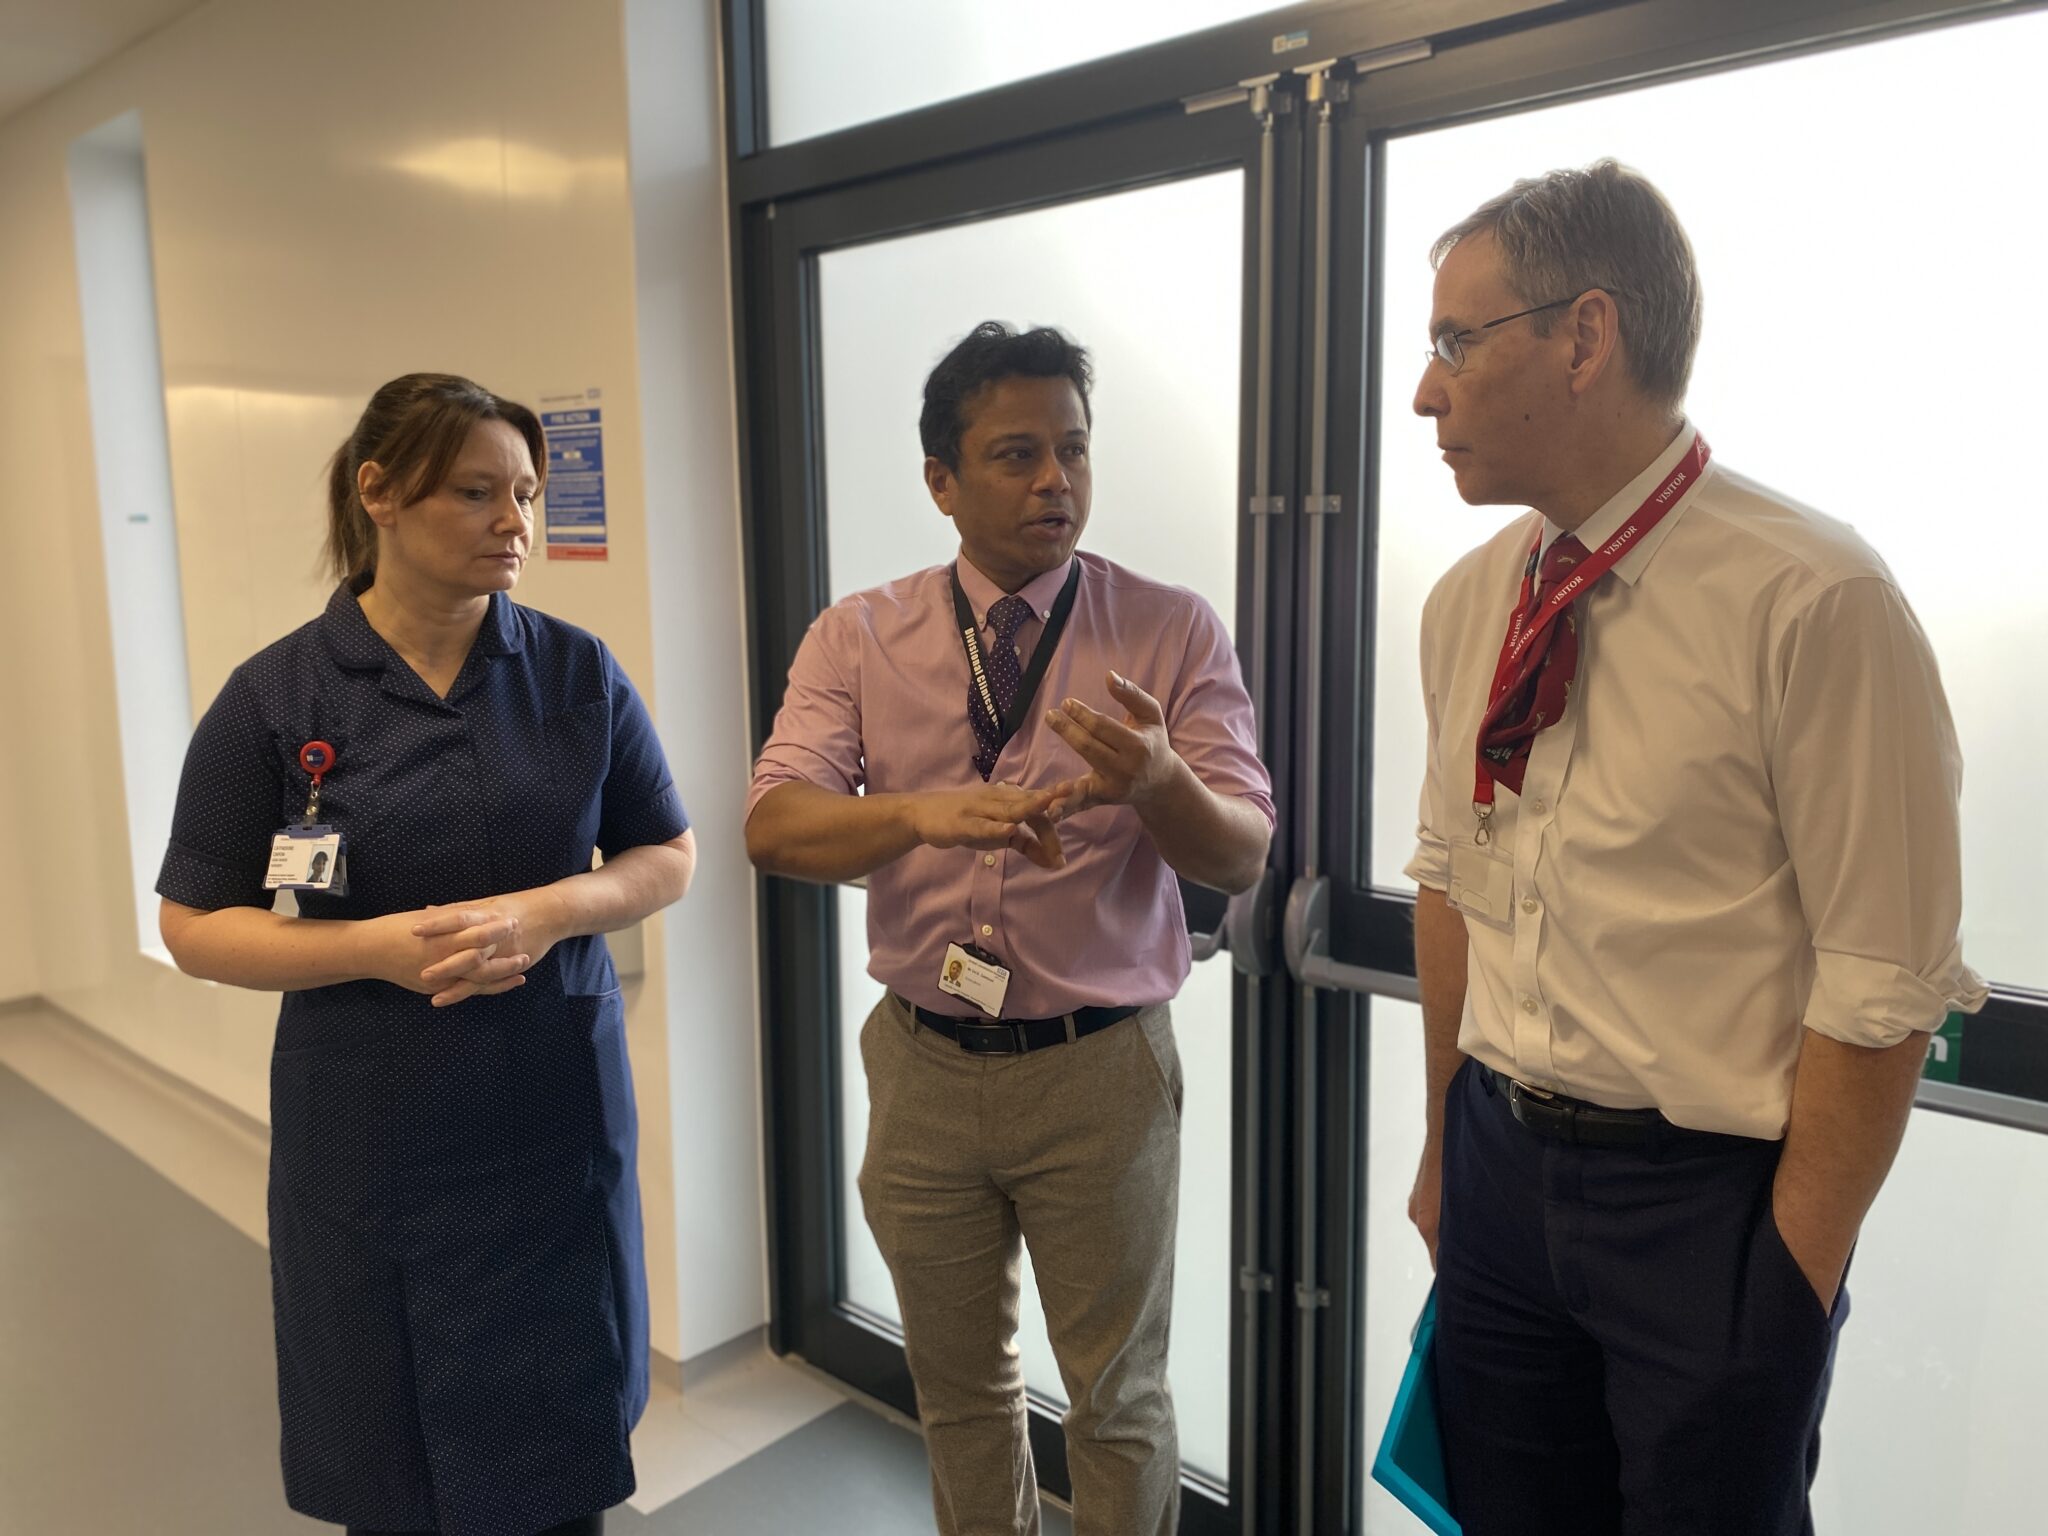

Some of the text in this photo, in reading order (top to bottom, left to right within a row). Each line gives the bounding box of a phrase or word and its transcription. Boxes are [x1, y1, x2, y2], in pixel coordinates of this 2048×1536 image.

[1656, 472, 1687, 504] VISITOR
[1603, 525, 1638, 556] VISITOR
[1551, 575, 1584, 606] VISITOR
[1509, 613, 1524, 647] VISITOR
[964, 627, 984, 676] Divisional
[976, 674, 996, 715] Clinical
